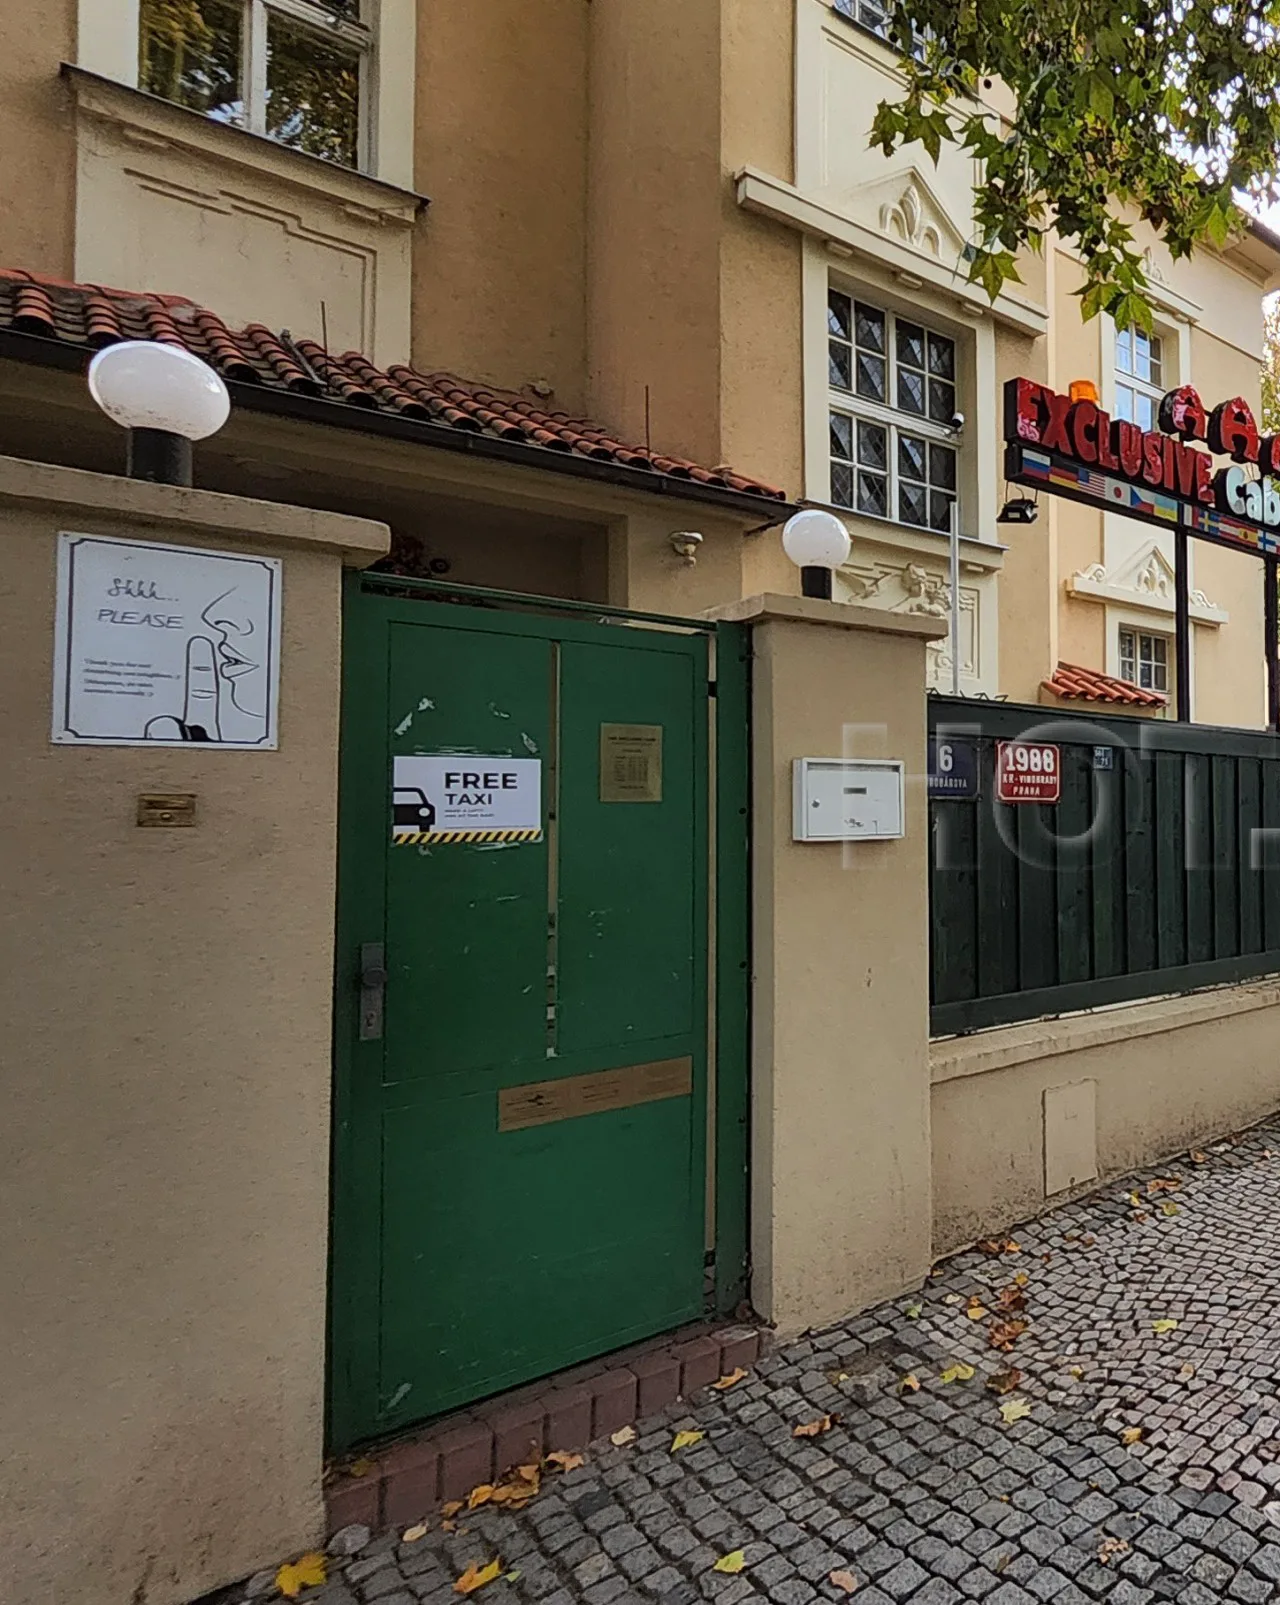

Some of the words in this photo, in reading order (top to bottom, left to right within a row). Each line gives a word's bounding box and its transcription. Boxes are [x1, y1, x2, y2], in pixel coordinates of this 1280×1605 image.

[1016, 378, 1216, 505] EXCLUSIVE
[98, 609, 184, 629] PLEASE
[939, 745, 953, 772] 6
[1005, 747, 1054, 772] 1988
[445, 772, 518, 789] FREE
[445, 793, 492, 805] TAXI
[1013, 786, 1040, 796] PRAHA
